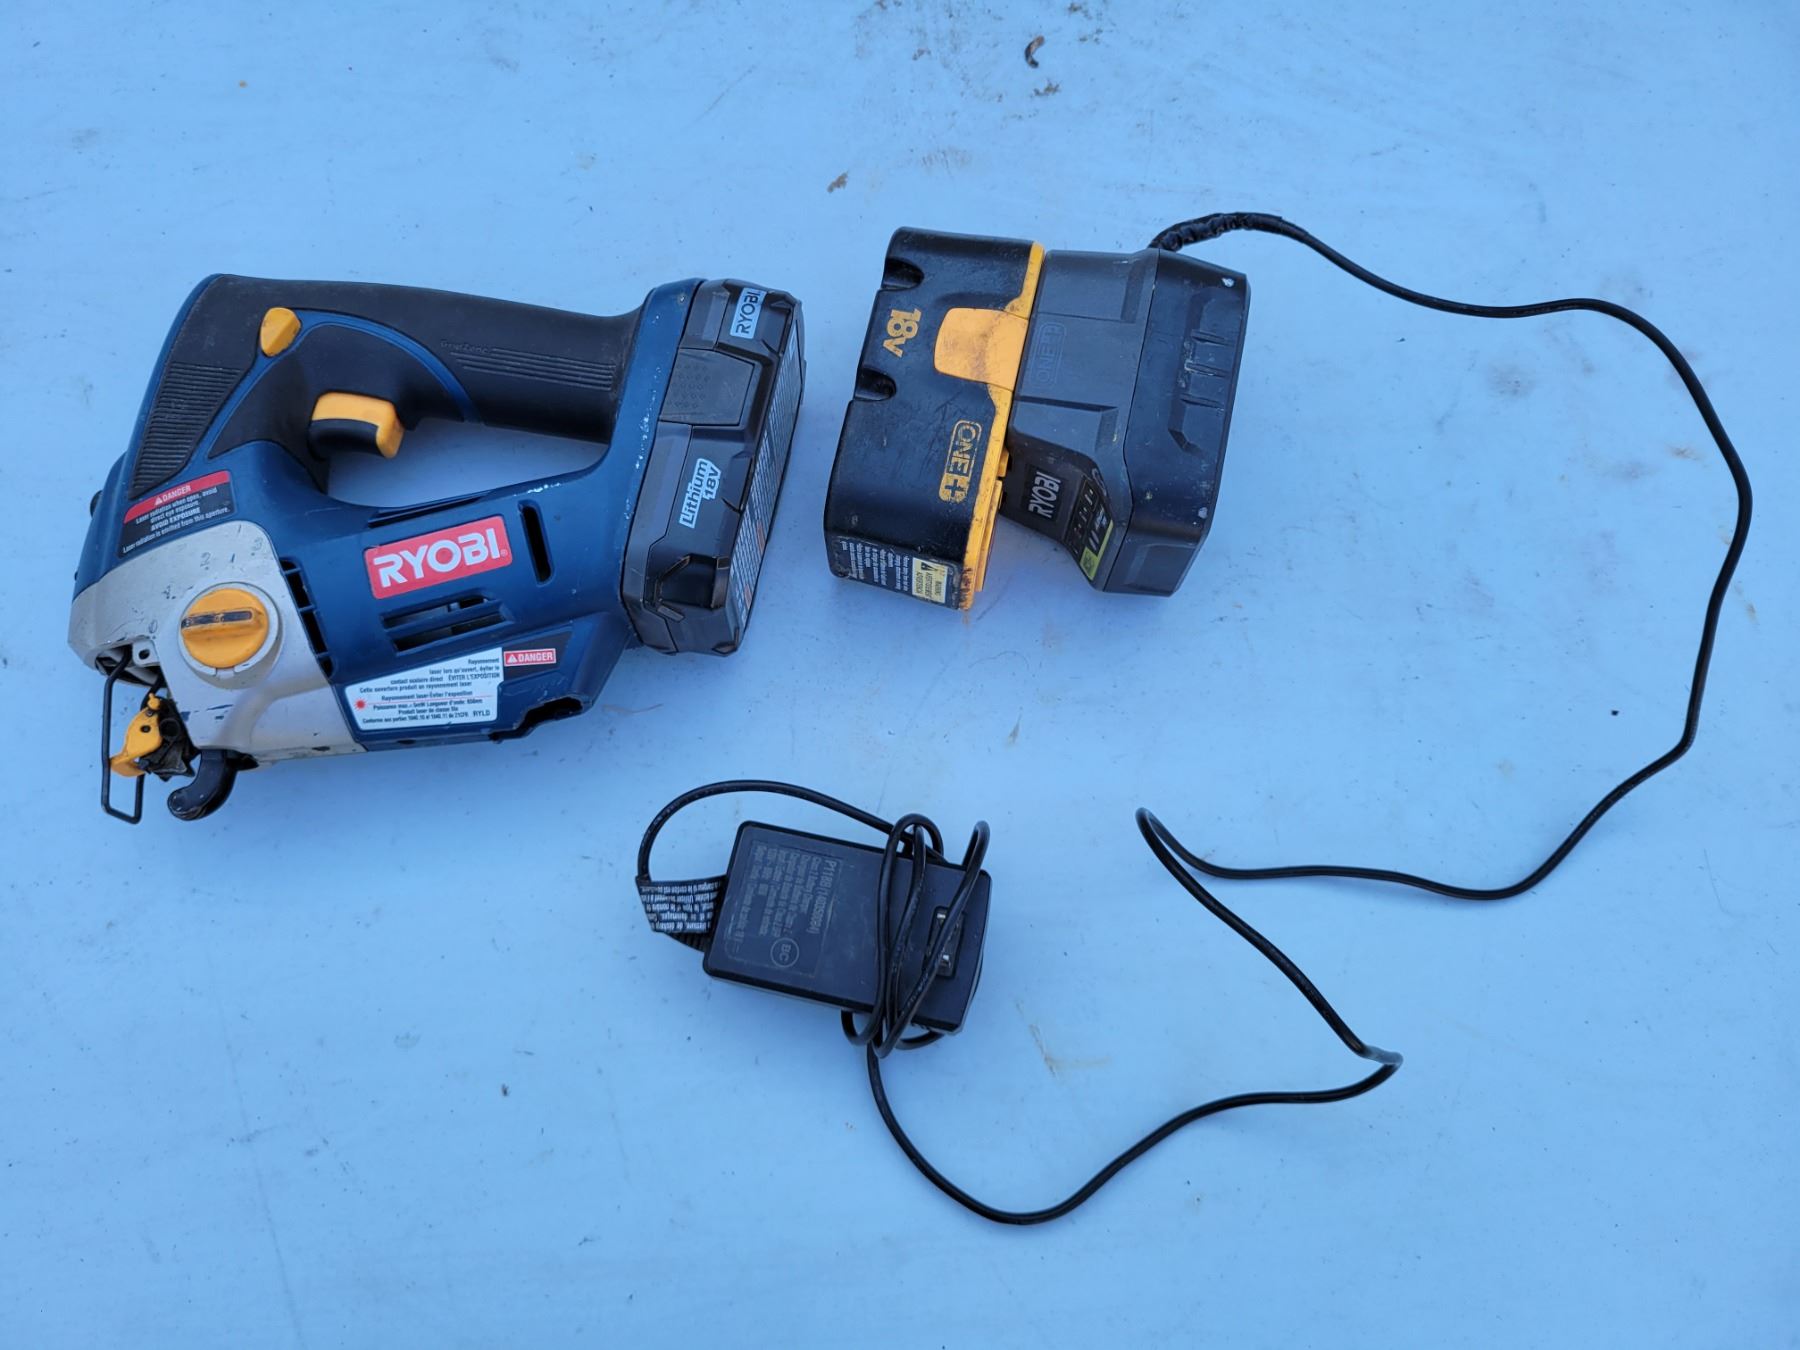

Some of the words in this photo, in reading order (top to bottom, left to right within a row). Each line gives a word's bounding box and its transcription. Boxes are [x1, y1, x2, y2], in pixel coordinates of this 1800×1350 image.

[735, 291, 761, 334] RYOBI
[163, 486, 191, 501] DANGER
[683, 460, 708, 523] Lithium
[704, 467, 719, 497] 18V
[1028, 471, 1062, 519] RYOBI
[149, 519, 169, 531] AVOID
[169, 508, 200, 523] EXPOSURE
[373, 528, 501, 588] RYOBI
[518, 651, 552, 662] DANGER
[778, 942, 792, 962] BC
